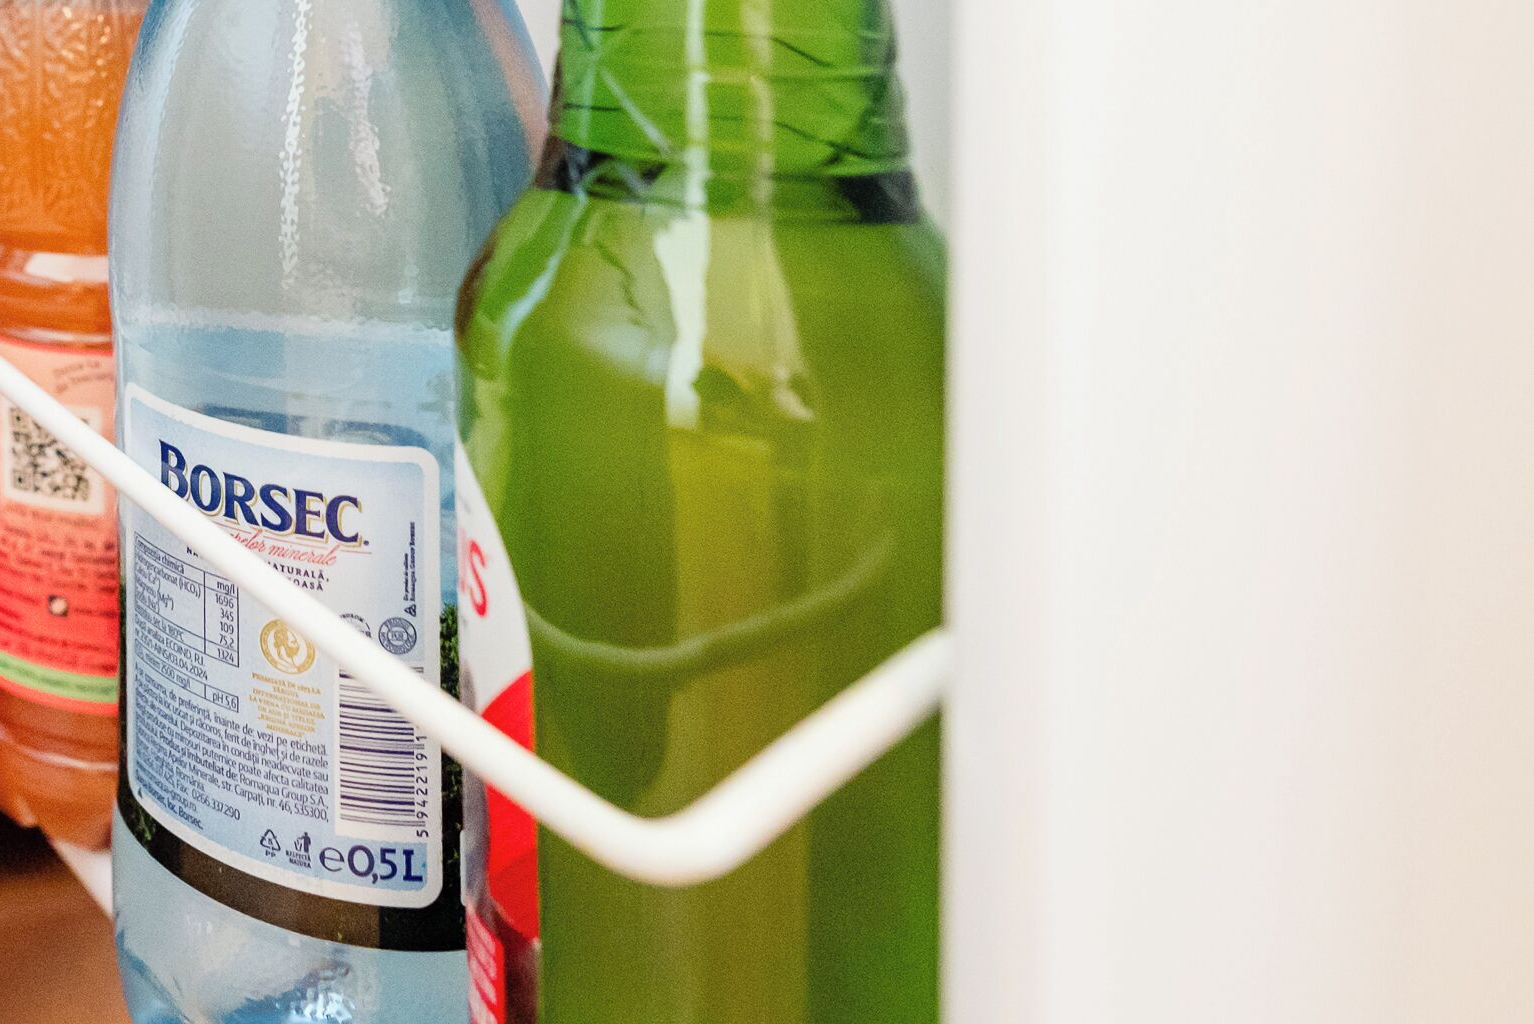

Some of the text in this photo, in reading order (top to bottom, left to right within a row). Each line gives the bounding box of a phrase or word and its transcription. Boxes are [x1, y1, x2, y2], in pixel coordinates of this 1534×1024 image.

[162, 554, 185, 574] chimică
[268, 543, 342, 567] minerale
[267, 561, 330, 582] ATURALĂ,
[217, 581, 235, 595] mg/l
[215, 593, 234, 609] 1696
[220, 607, 234, 622] 345
[220, 621, 234, 636] 109
[220, 634, 234, 649] 75,2
[217, 648, 234, 663] 1324
[212, 692, 224, 704] pH
[169, 689, 177, 702] de
[214, 711, 240, 732] înainte
[257, 730, 274, 744] vezi
[276, 736, 288, 750] pe
[172, 704, 188, 721] uscat
[224, 728, 240, 746] ferit
[241, 737, 252, 747] de
[289, 750, 301, 764] de
[302, 756, 328, 769] razele
[180, 720, 221, 750] Depozitarea
[261, 757, 312, 777] neadecvate
[312, 770, 329, 783] sau
[175, 731, 201, 752] mirosuri
[201, 746, 237, 770] puternice
[238, 761, 262, 777] poate
[263, 769, 290, 787] afecta
[291, 777, 329, 796] calitatea
[239, 773, 281, 796] Romaqua
[281, 786, 308, 805] Group
[266, 796, 278, 809] nr.
[278, 799, 293, 815] 46,
[294, 803, 329, 823] 535300,
